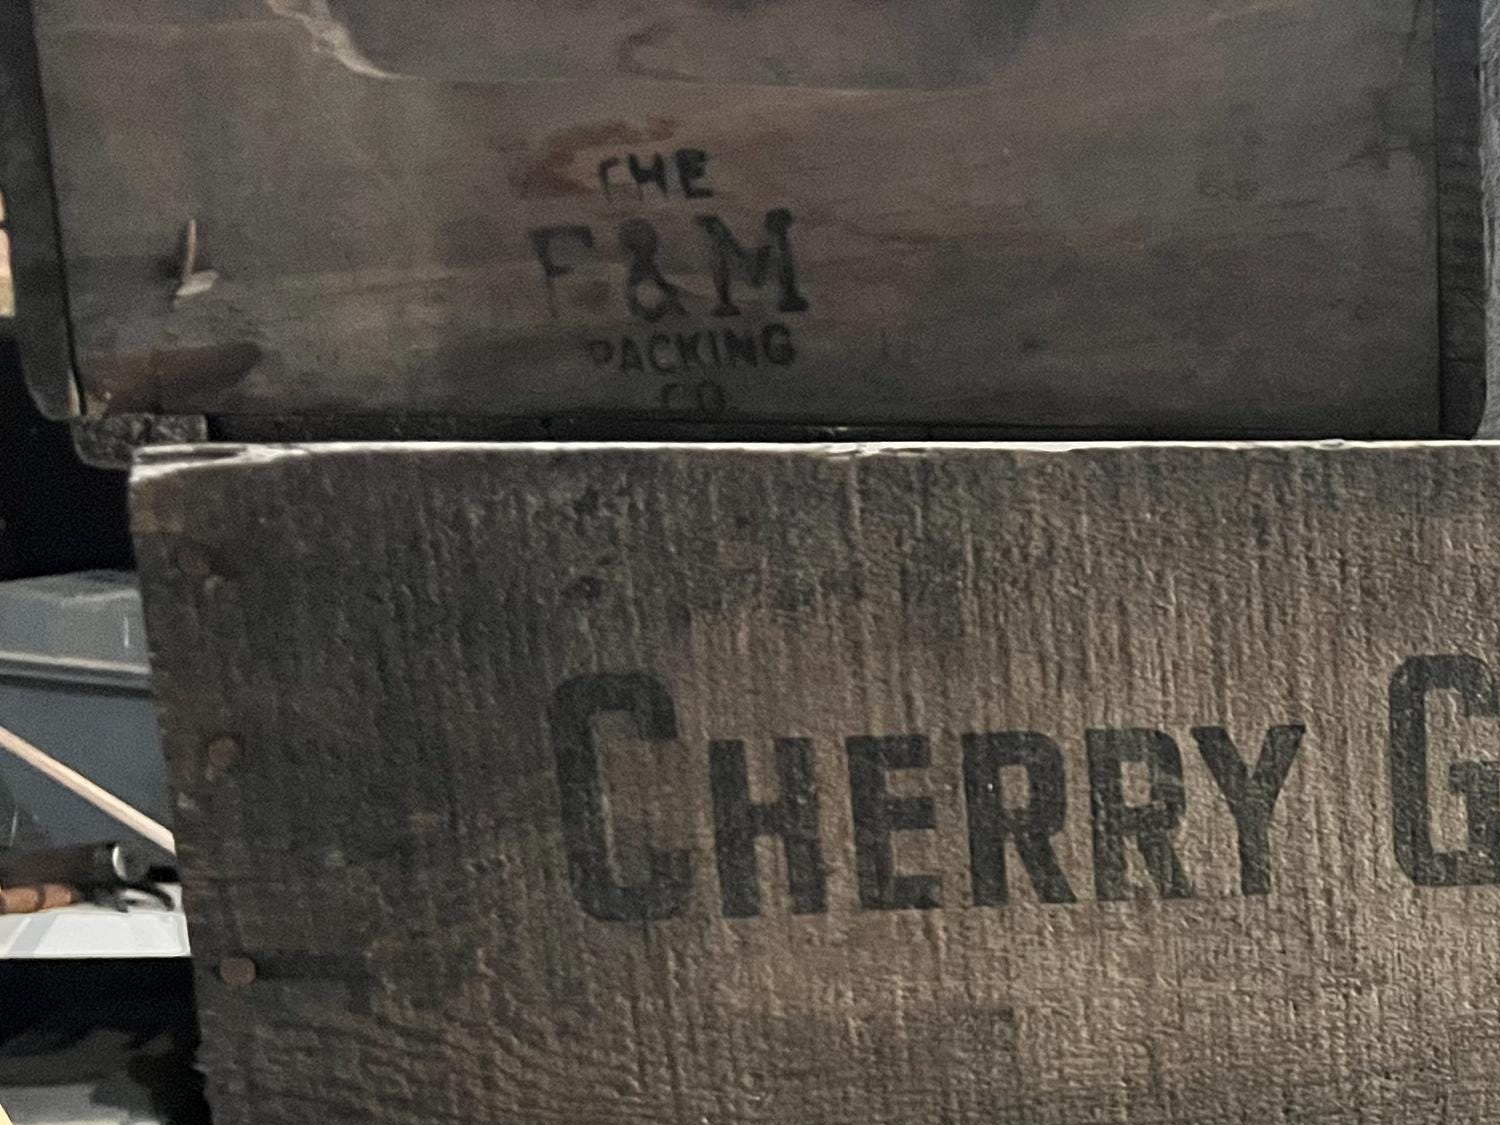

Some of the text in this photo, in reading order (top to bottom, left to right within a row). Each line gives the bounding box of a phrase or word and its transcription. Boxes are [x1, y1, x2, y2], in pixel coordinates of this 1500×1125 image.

[599, 148, 713, 199] THE
[586, 323, 794, 374] PACKING
[548, 670, 1306, 922] CHERRY
